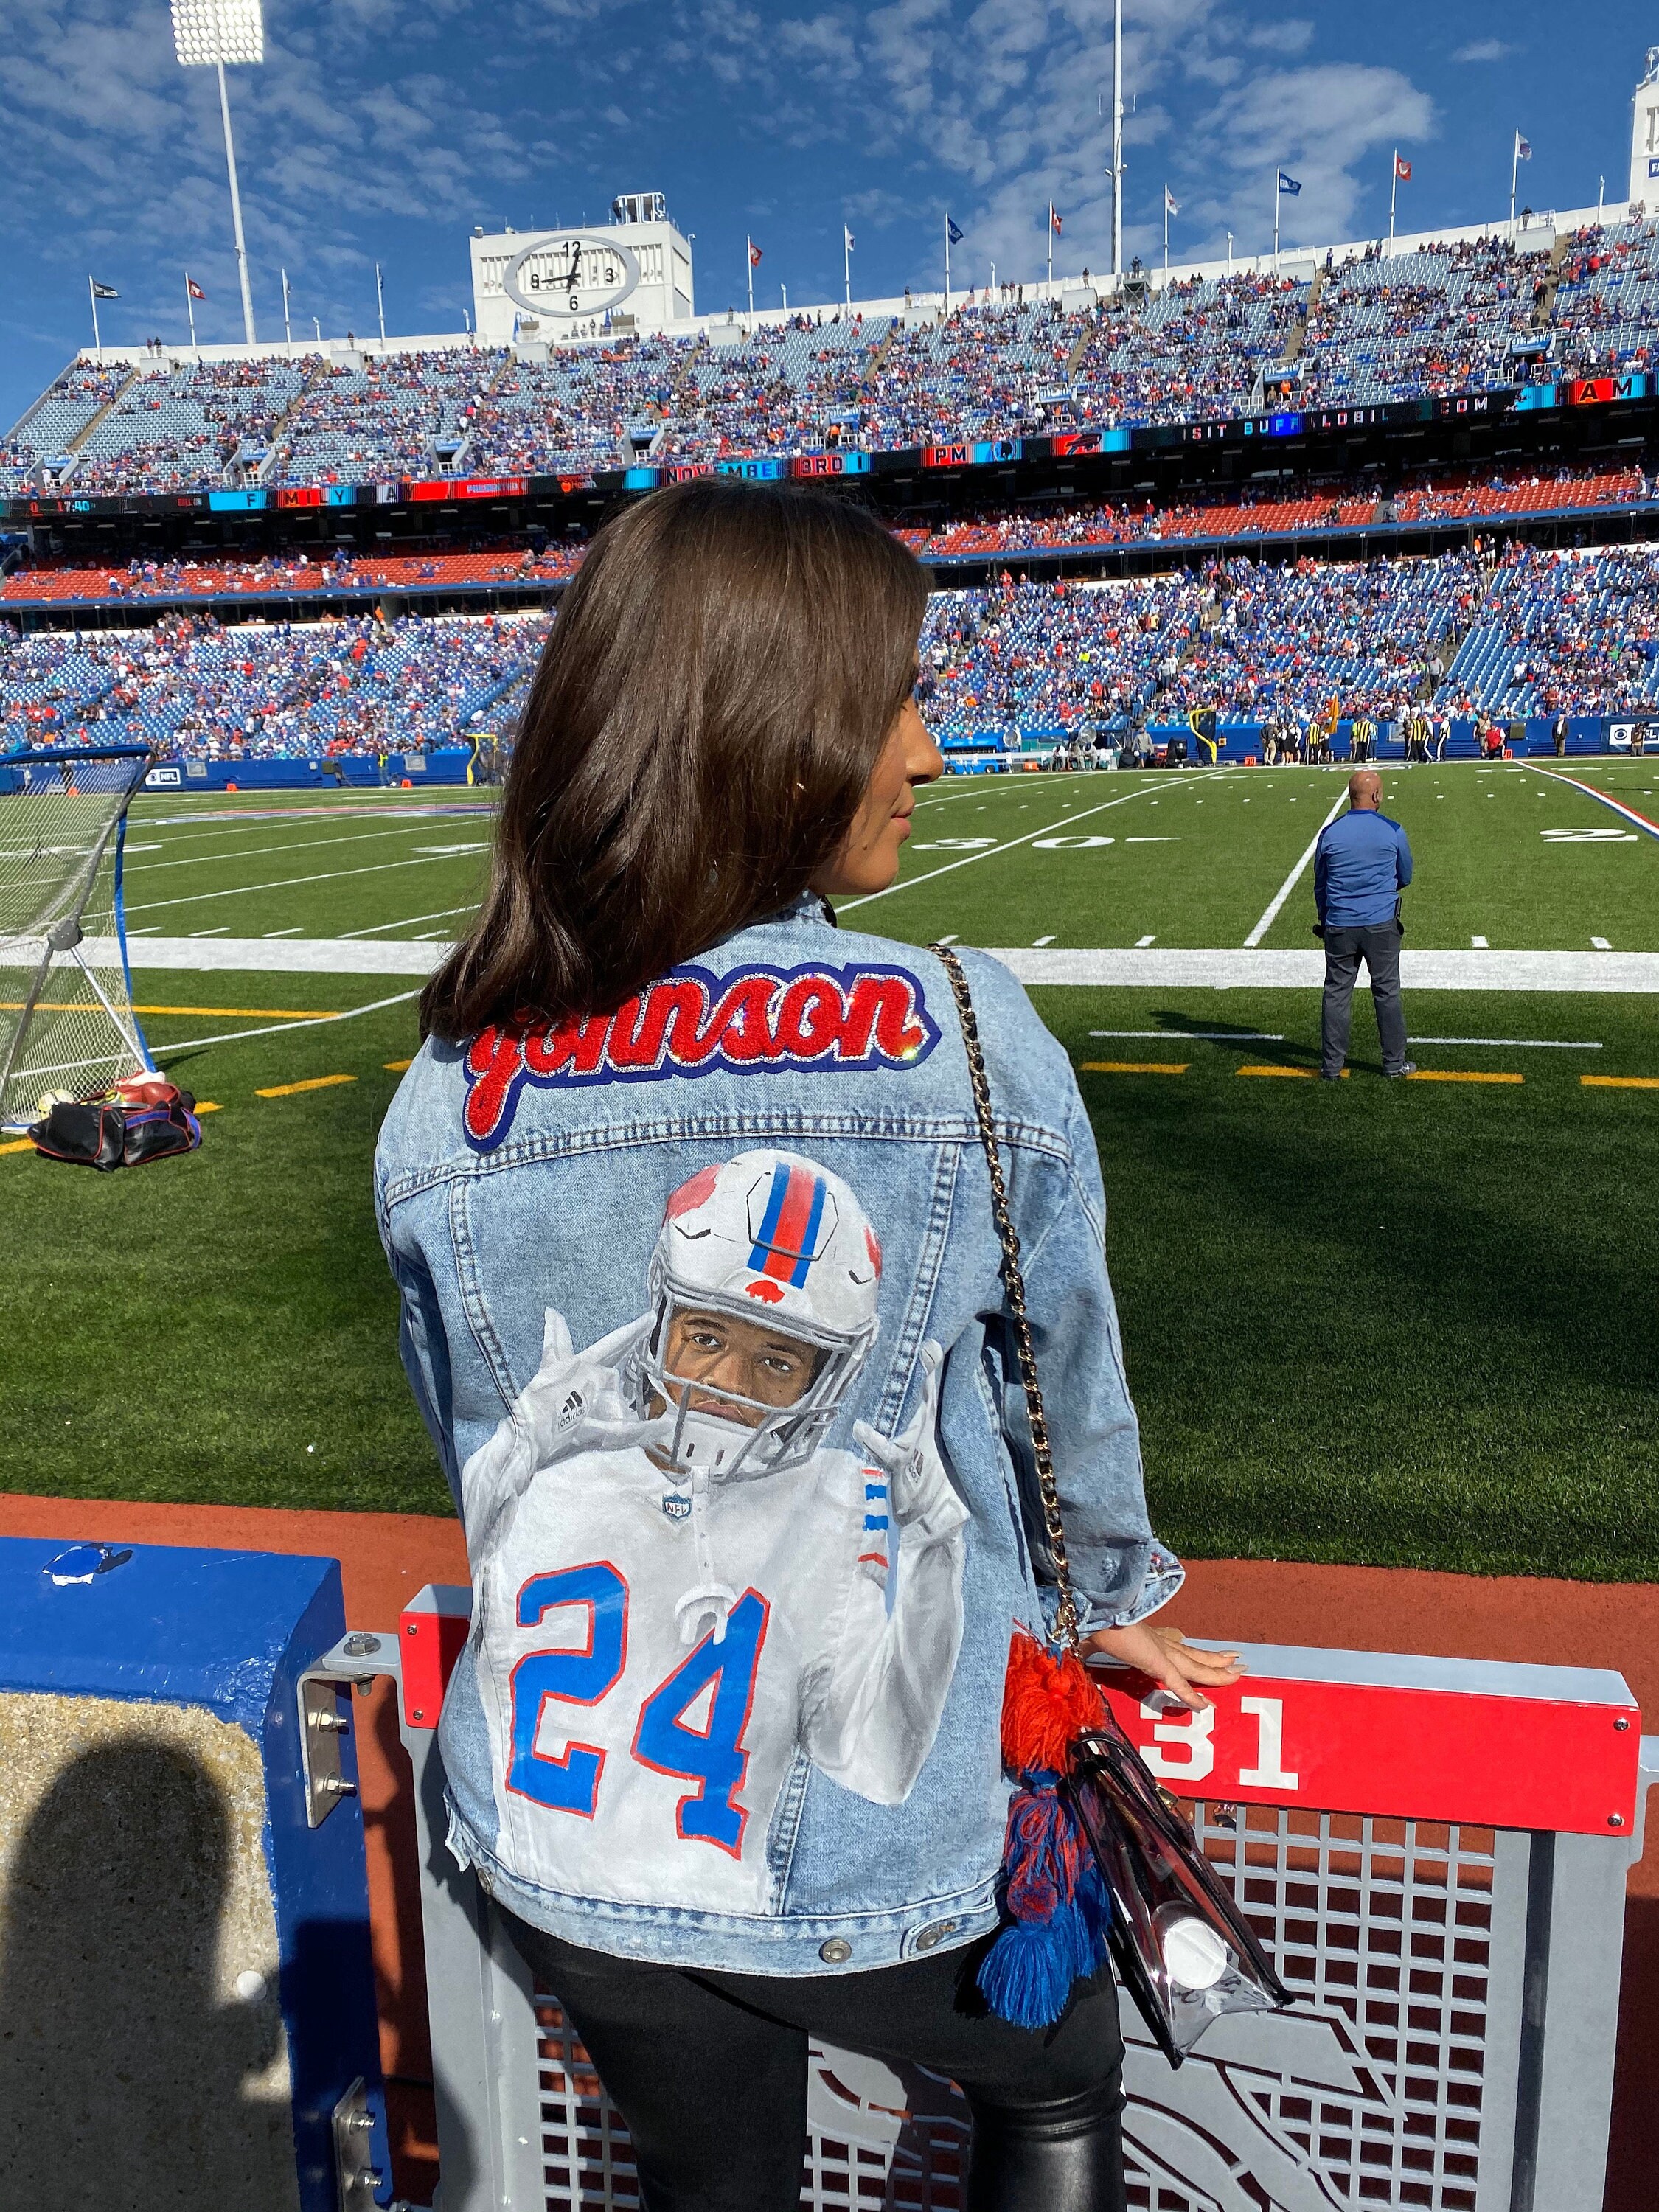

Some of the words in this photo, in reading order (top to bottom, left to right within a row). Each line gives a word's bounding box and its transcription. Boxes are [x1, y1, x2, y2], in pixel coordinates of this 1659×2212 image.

[563, 241, 580, 258] 12
[531, 274, 539, 289] 9
[605, 268, 614, 283] 3
[570, 296, 579, 310] 6
[935, 445, 966, 463] PM
[246, 489, 344, 507] FMILY
[160, 772, 177, 781] NFL
[1539, 828, 1638, 842] 2
[667, 1503, 687, 1515] NFL
[506, 1559, 771, 1861] 24
[1139, 1689, 1299, 1790] 31
